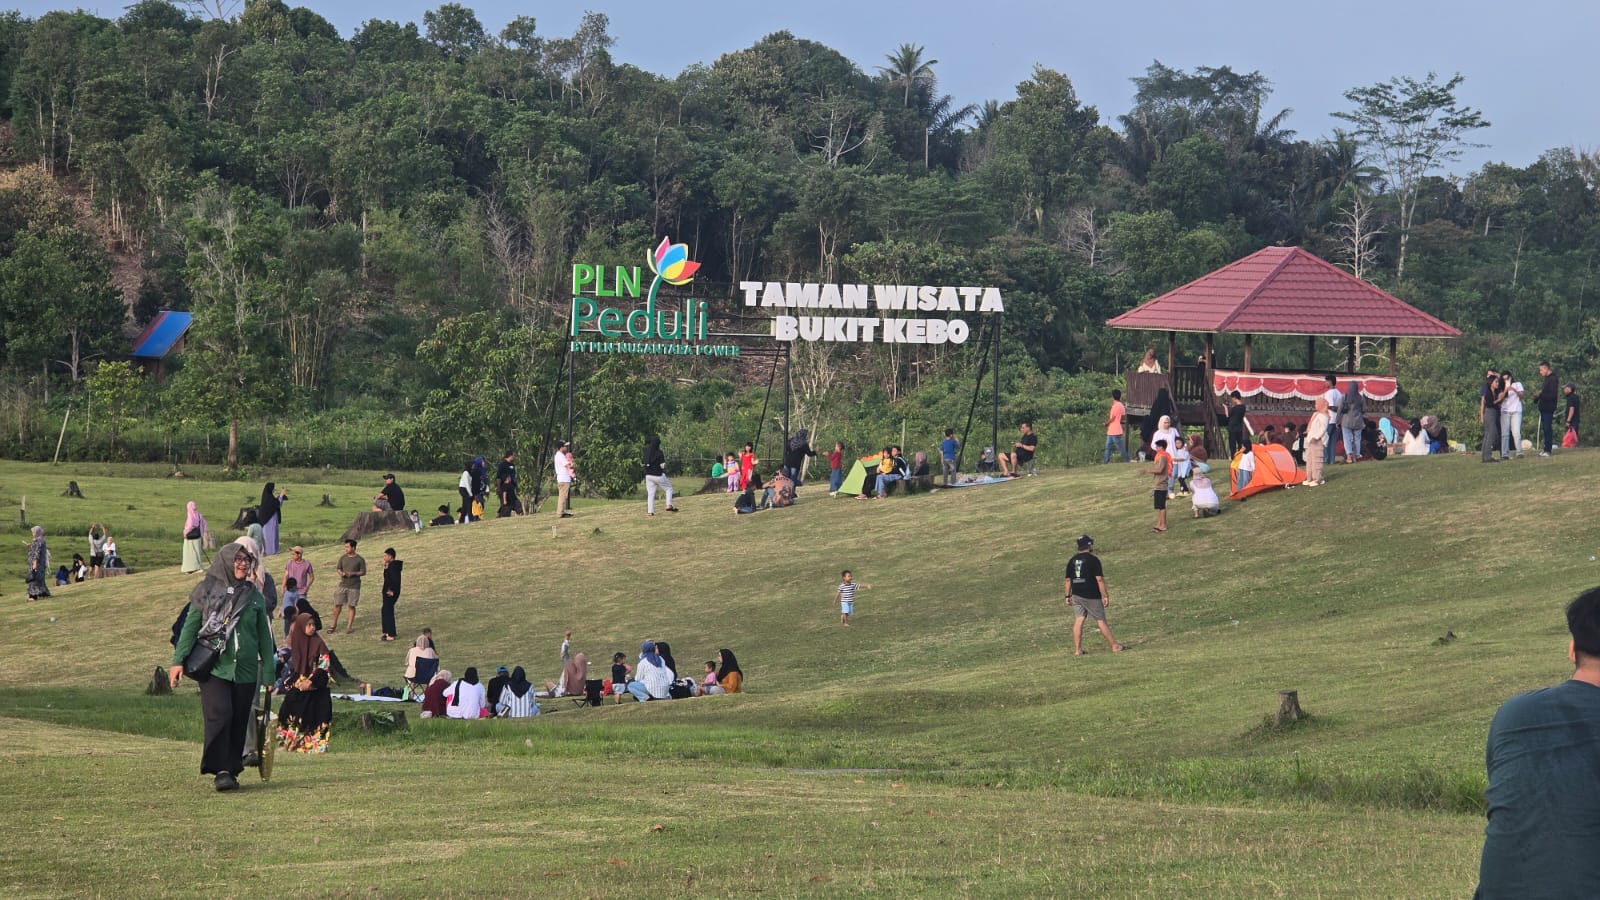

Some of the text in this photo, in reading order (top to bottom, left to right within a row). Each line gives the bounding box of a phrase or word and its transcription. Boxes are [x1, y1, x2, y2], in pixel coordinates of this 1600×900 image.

[572, 263, 641, 298] PLN
[739, 281, 1004, 312] TAMAN WISATA
[571, 296, 708, 341] Peduli
[775, 315, 969, 345] BUKIT KEBO
[571, 341, 740, 357] BY PLN NUSANTARA POWER
